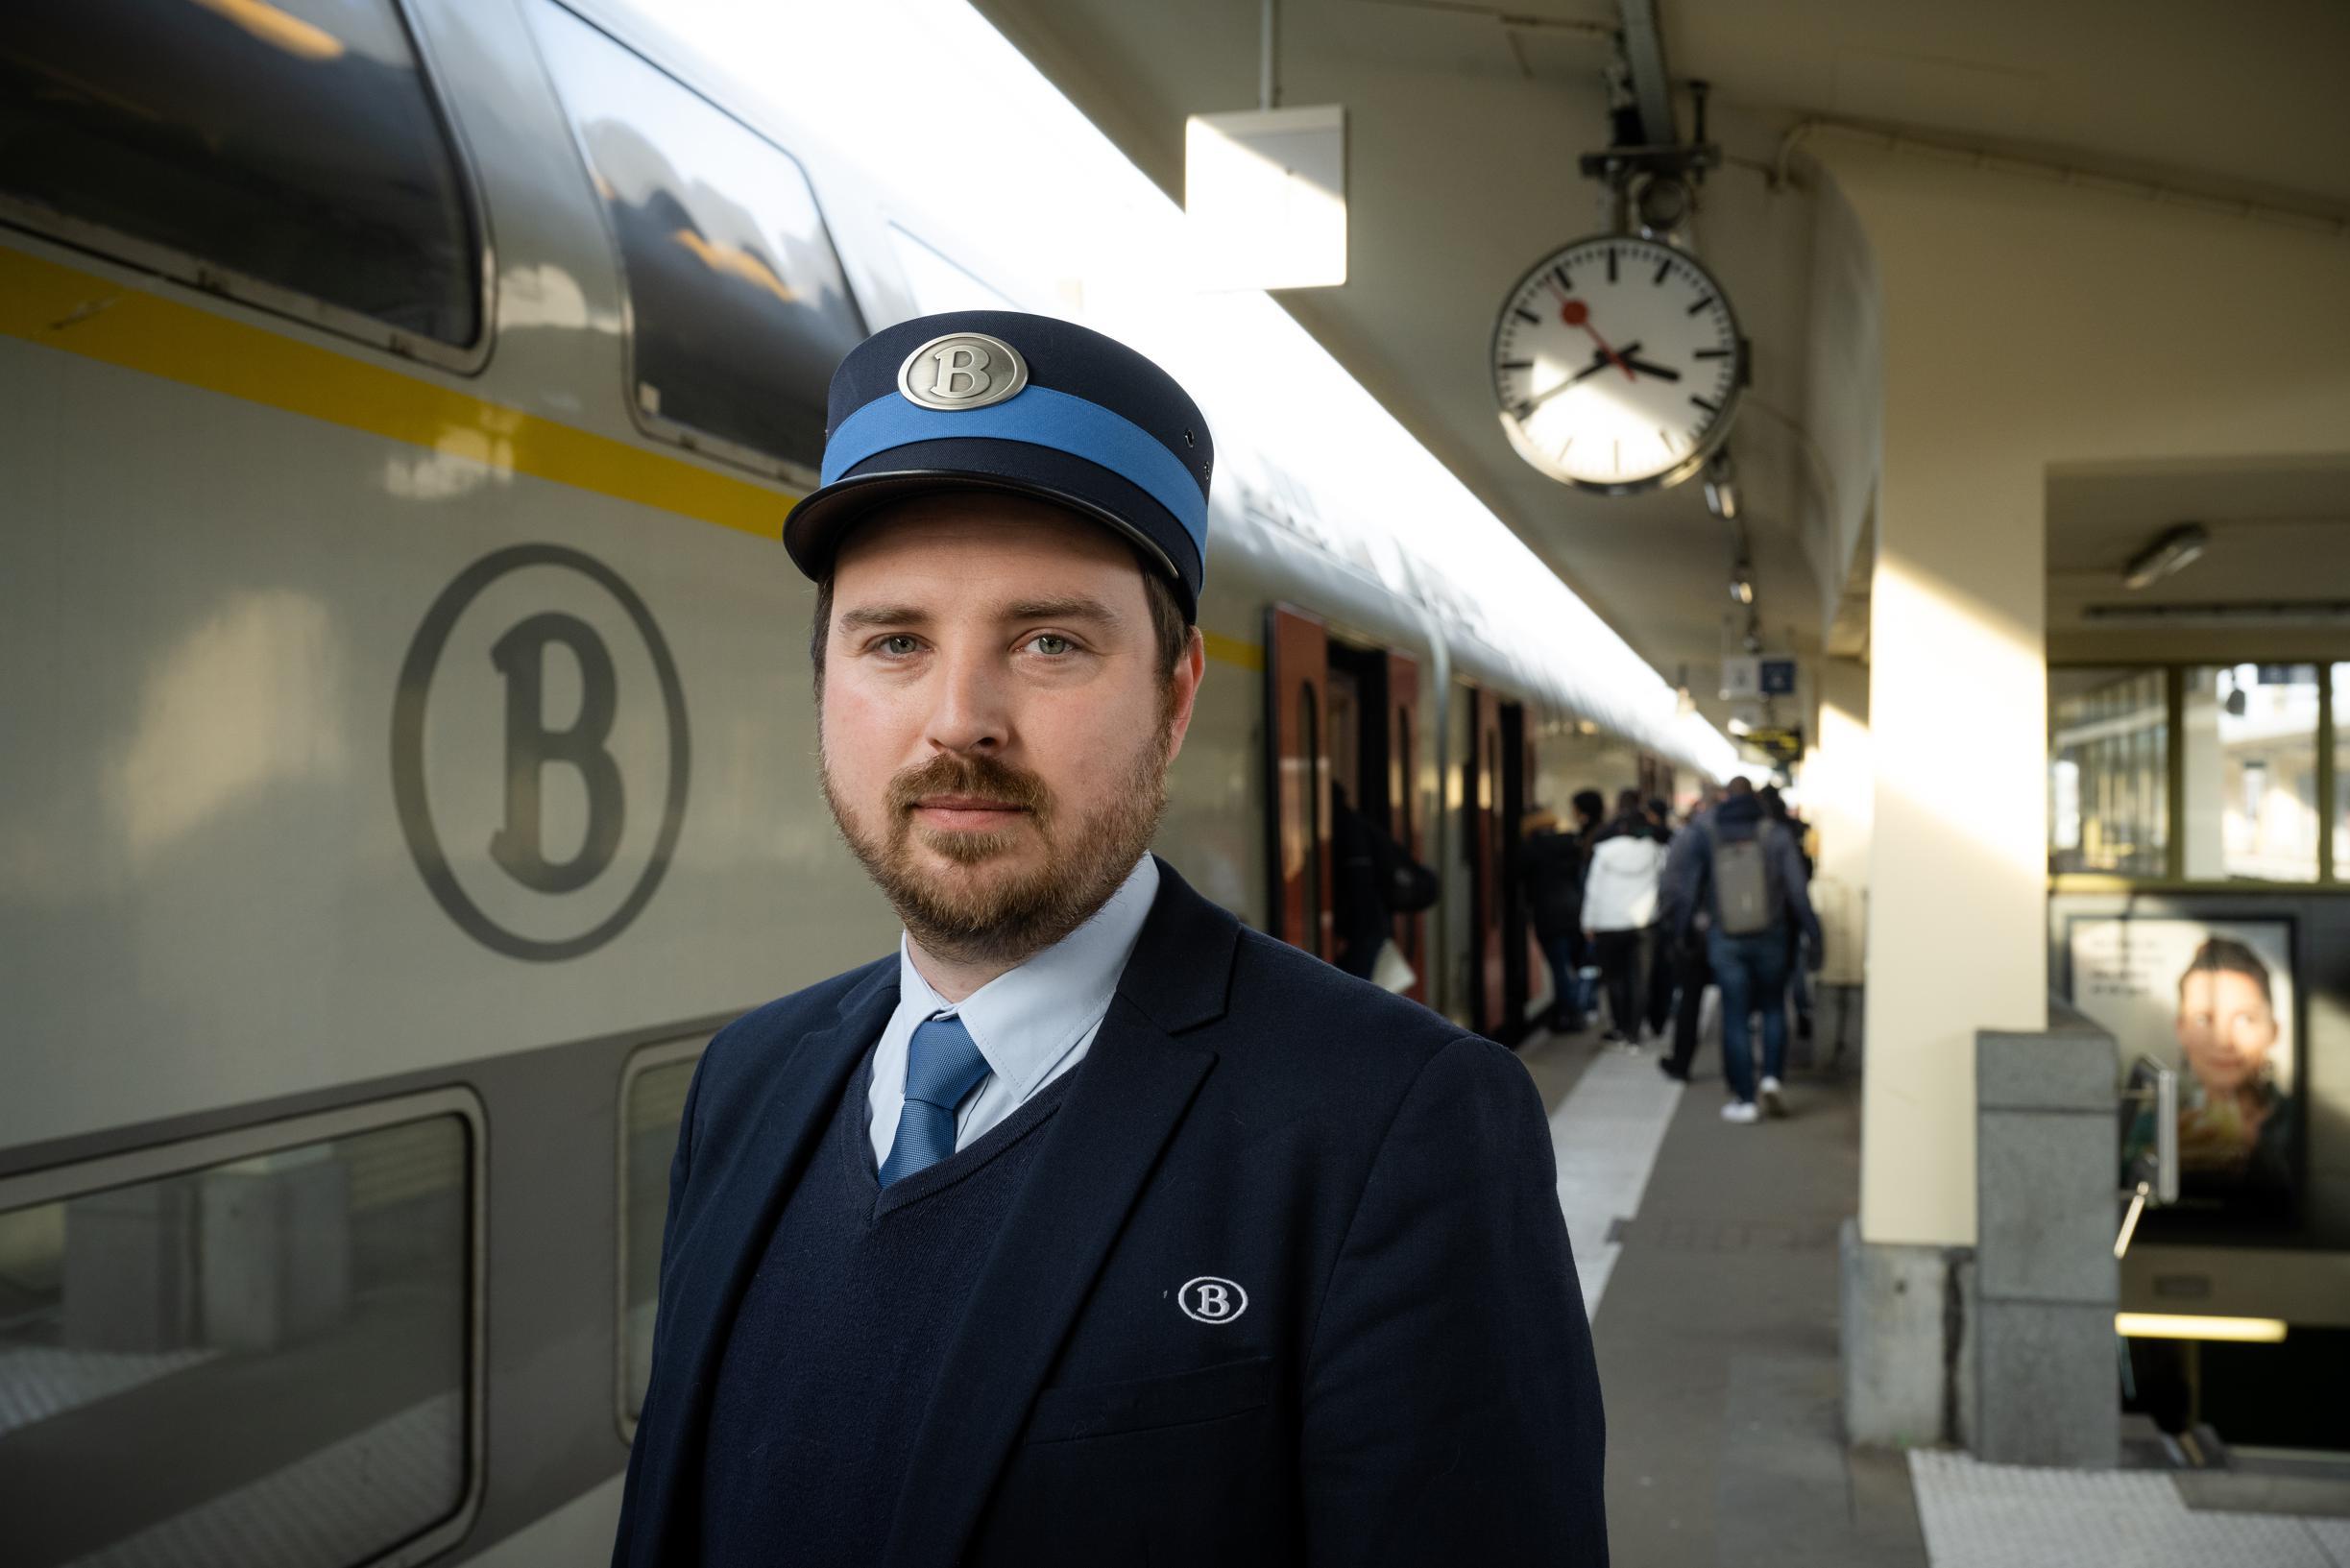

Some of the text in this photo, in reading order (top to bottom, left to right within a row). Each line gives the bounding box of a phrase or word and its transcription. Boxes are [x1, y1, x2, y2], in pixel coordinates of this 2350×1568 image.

[930, 345, 991, 398] B
[489, 611, 626, 895] B
[1197, 1285, 1230, 1316] B
